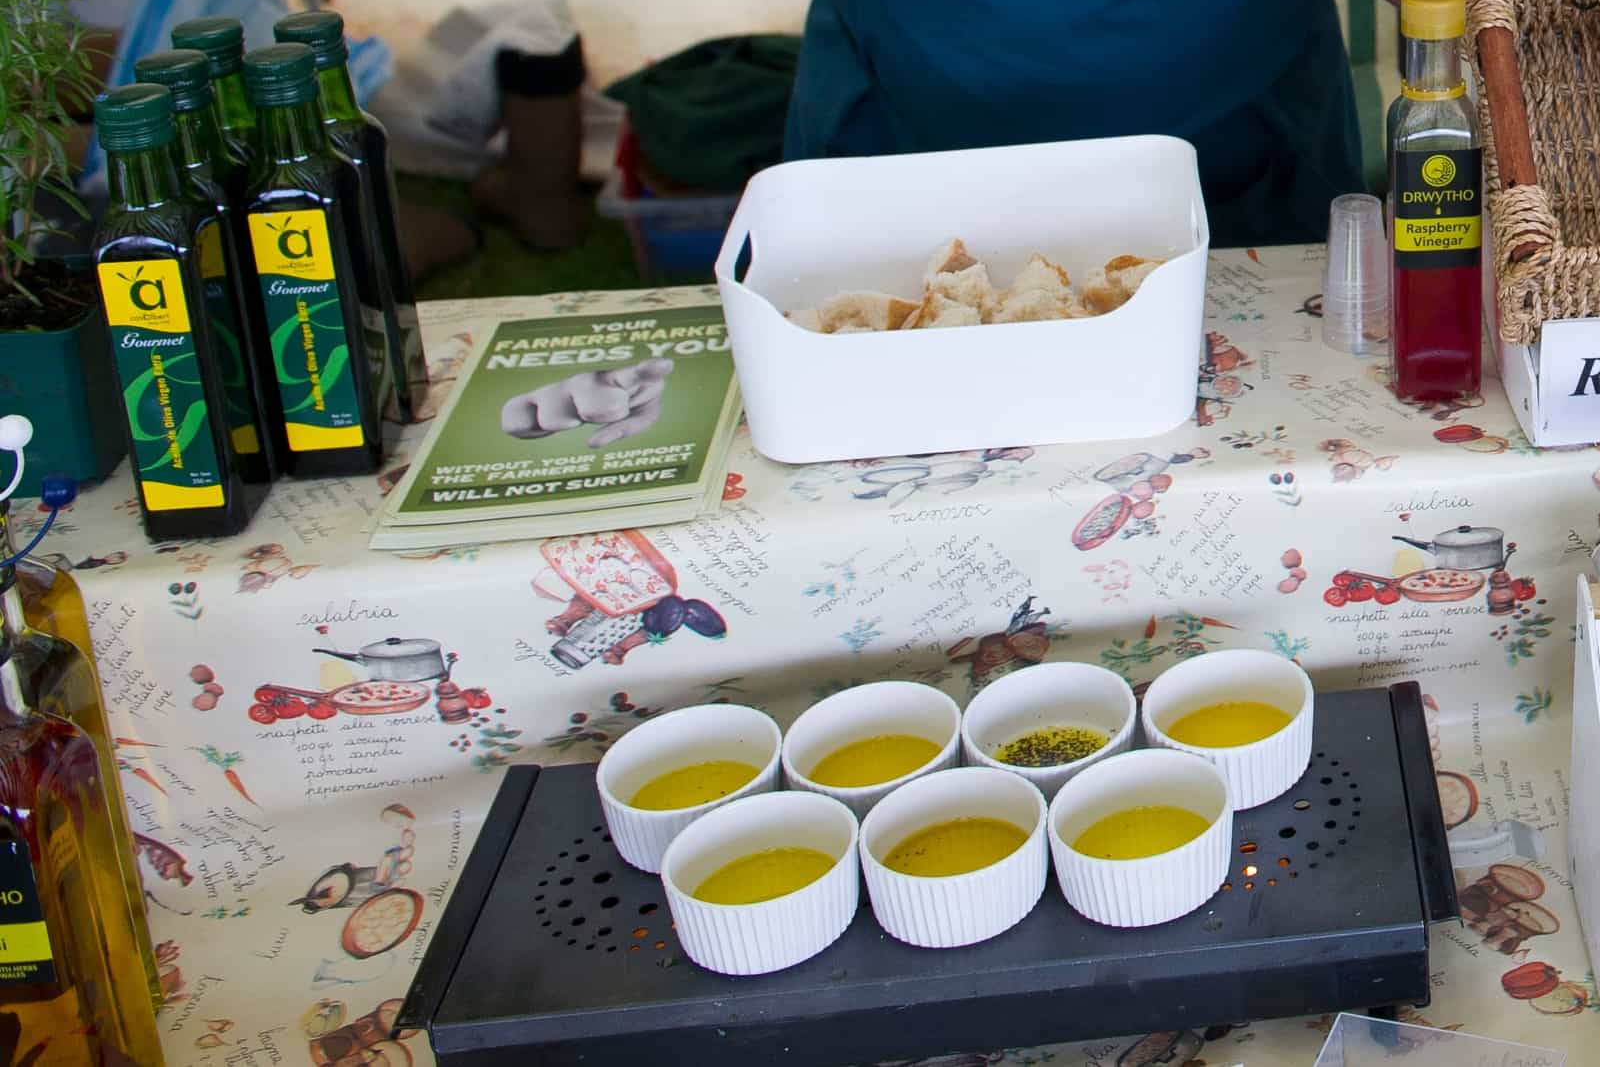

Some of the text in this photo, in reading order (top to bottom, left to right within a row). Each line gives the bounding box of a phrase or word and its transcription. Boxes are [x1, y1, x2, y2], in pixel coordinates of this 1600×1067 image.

[1403, 189, 1474, 205] DRWYTHO
[1406, 222, 1471, 236] Raspberry
[1414, 236, 1464, 249] Vinegar
[268, 280, 328, 295] Gourmet
[591, 319, 656, 334] YOUR
[121, 332, 184, 348] Gourmet
[486, 343, 634, 370] NEEDS
[435, 443, 696, 476] WITHOUT YOUR SUPPORT
[431, 452, 693, 484] THE FARMERS MARKET
[432, 468, 678, 502] WILL NOT SURVIVE
